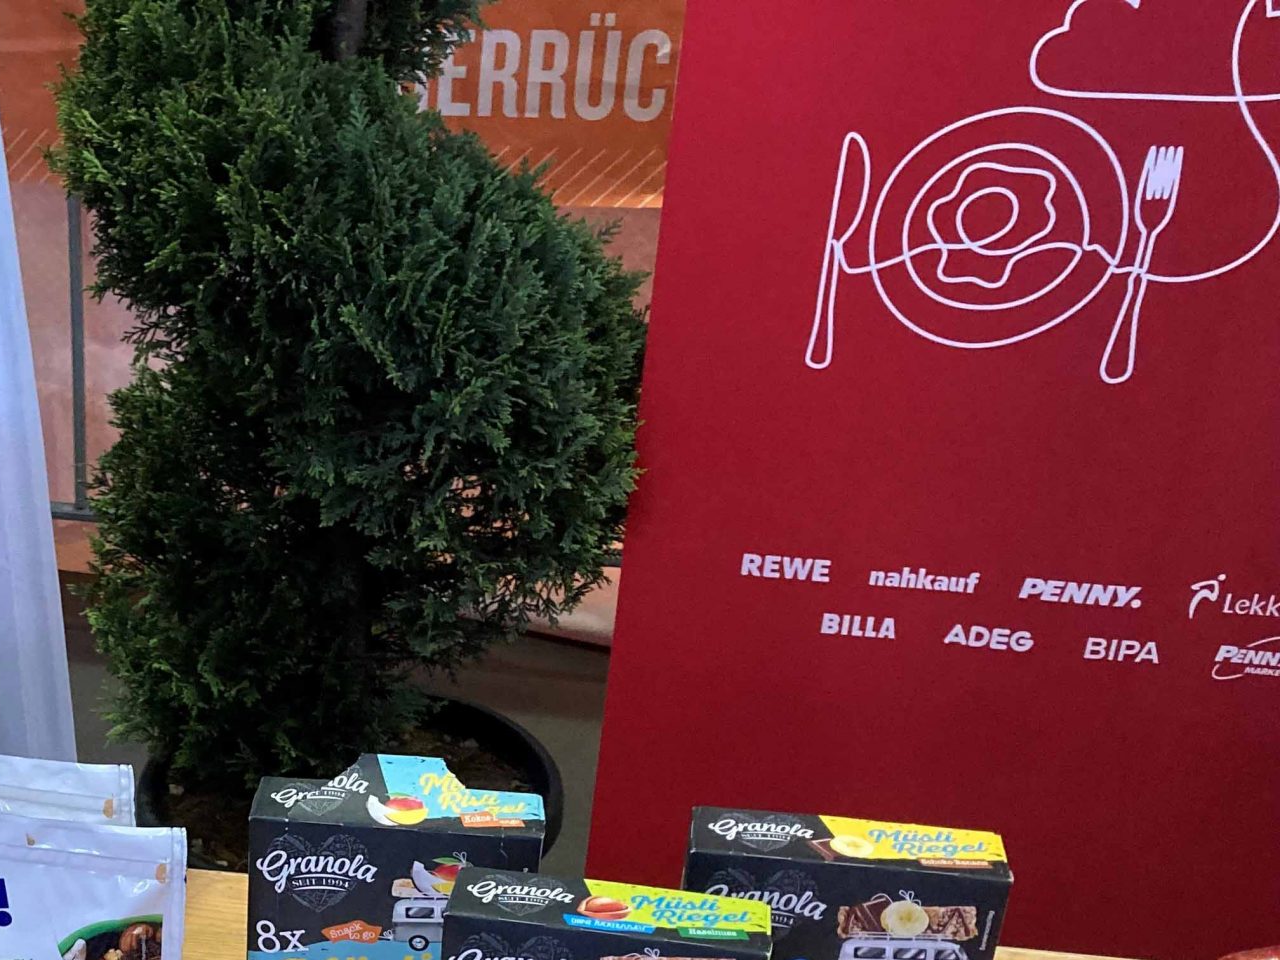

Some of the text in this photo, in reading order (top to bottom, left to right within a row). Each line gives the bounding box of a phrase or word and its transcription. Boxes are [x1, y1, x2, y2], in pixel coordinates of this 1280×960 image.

[402, 13, 671, 122] ERRÜC
[741, 553, 831, 582] REWE
[869, 568, 980, 594] nahkauf
[820, 613, 1280, 667] BILLA ADEG BIPA PENN
[708, 818, 815, 841] Granola
[868, 829, 953, 844] Müsli
[891, 841, 988, 857] Riegel
[256, 849, 378, 894] Granola
[291, 877, 350, 889] SEIT 1994
[467, 879, 576, 904] Granola
[631, 893, 720, 914] Müsli
[651, 909, 752, 925] Riegel
[256, 919, 310, 954] 8x
[329, 923, 363, 940] Snack
[349, 930, 376, 942] to go
[688, 927, 738, 938] Haselnuss
